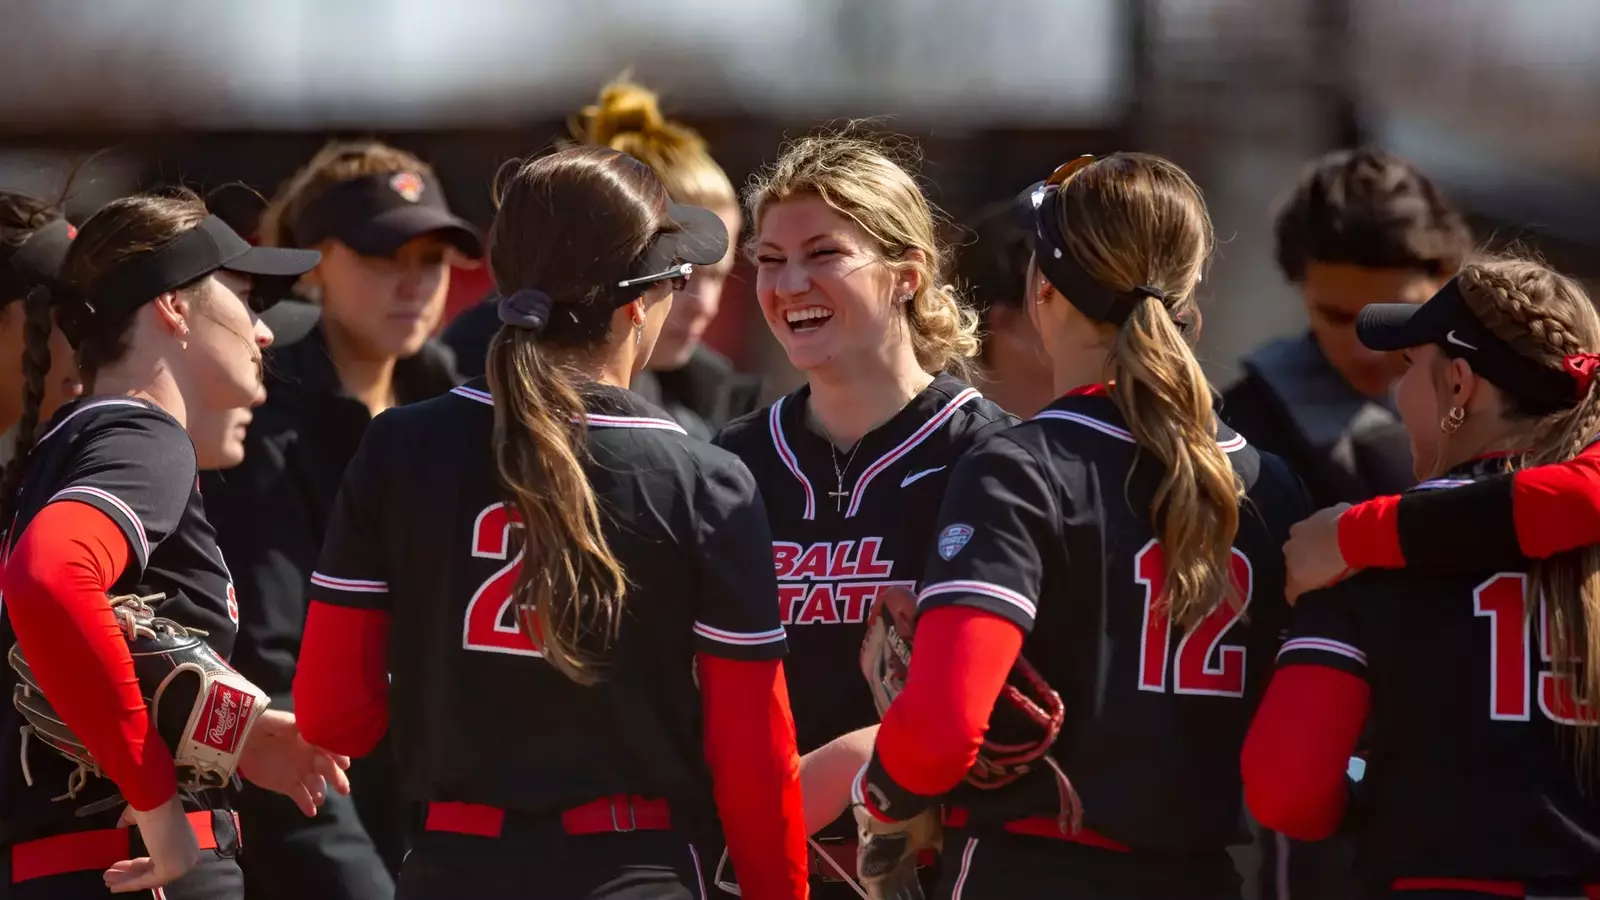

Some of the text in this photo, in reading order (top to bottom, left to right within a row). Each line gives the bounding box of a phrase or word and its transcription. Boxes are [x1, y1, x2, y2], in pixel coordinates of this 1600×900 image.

[772, 537, 894, 580] BALL
[777, 580, 916, 625] TAT
[1135, 538, 1253, 698] 12
[209, 690, 236, 744] Rawlings
